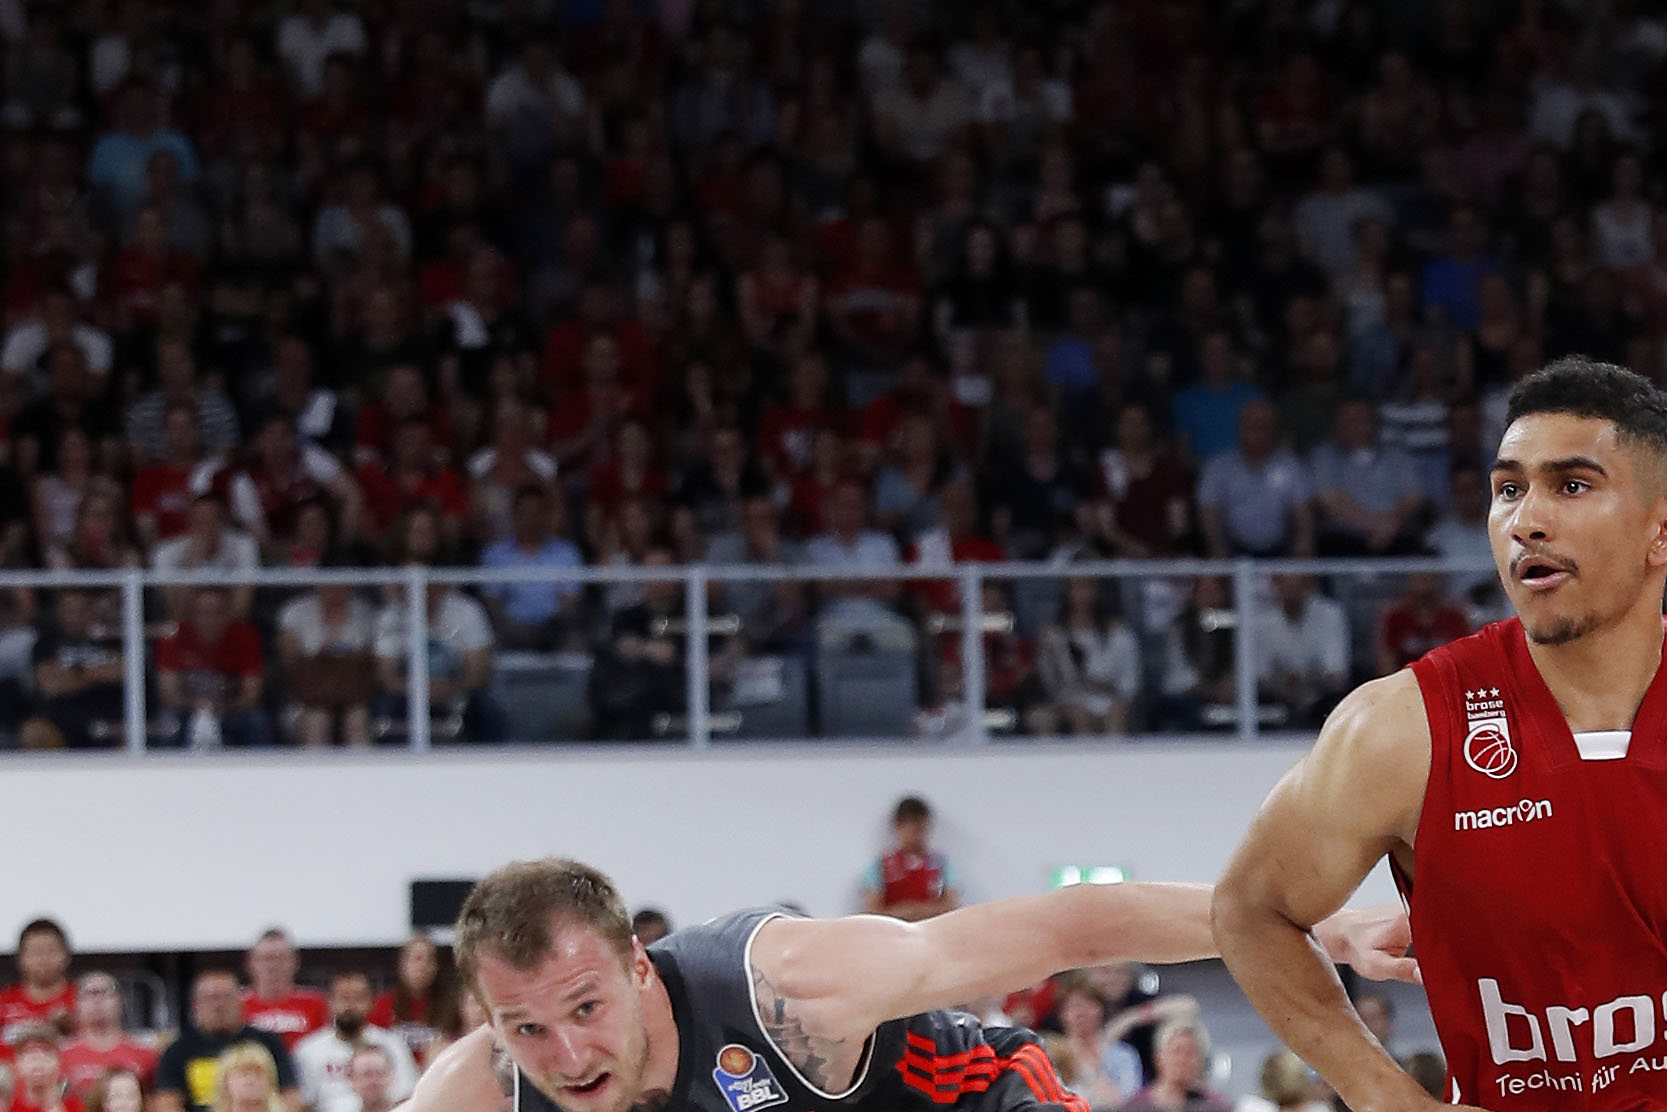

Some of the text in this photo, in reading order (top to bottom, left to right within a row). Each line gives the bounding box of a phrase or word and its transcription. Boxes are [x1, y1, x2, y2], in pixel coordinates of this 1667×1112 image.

[1465, 699, 1504, 711] brose
[1455, 799, 1554, 831] macron
[1495, 1069, 1584, 1098] Techni
[1591, 1064, 1621, 1094] für
[736, 1086, 780, 1111] BBL
